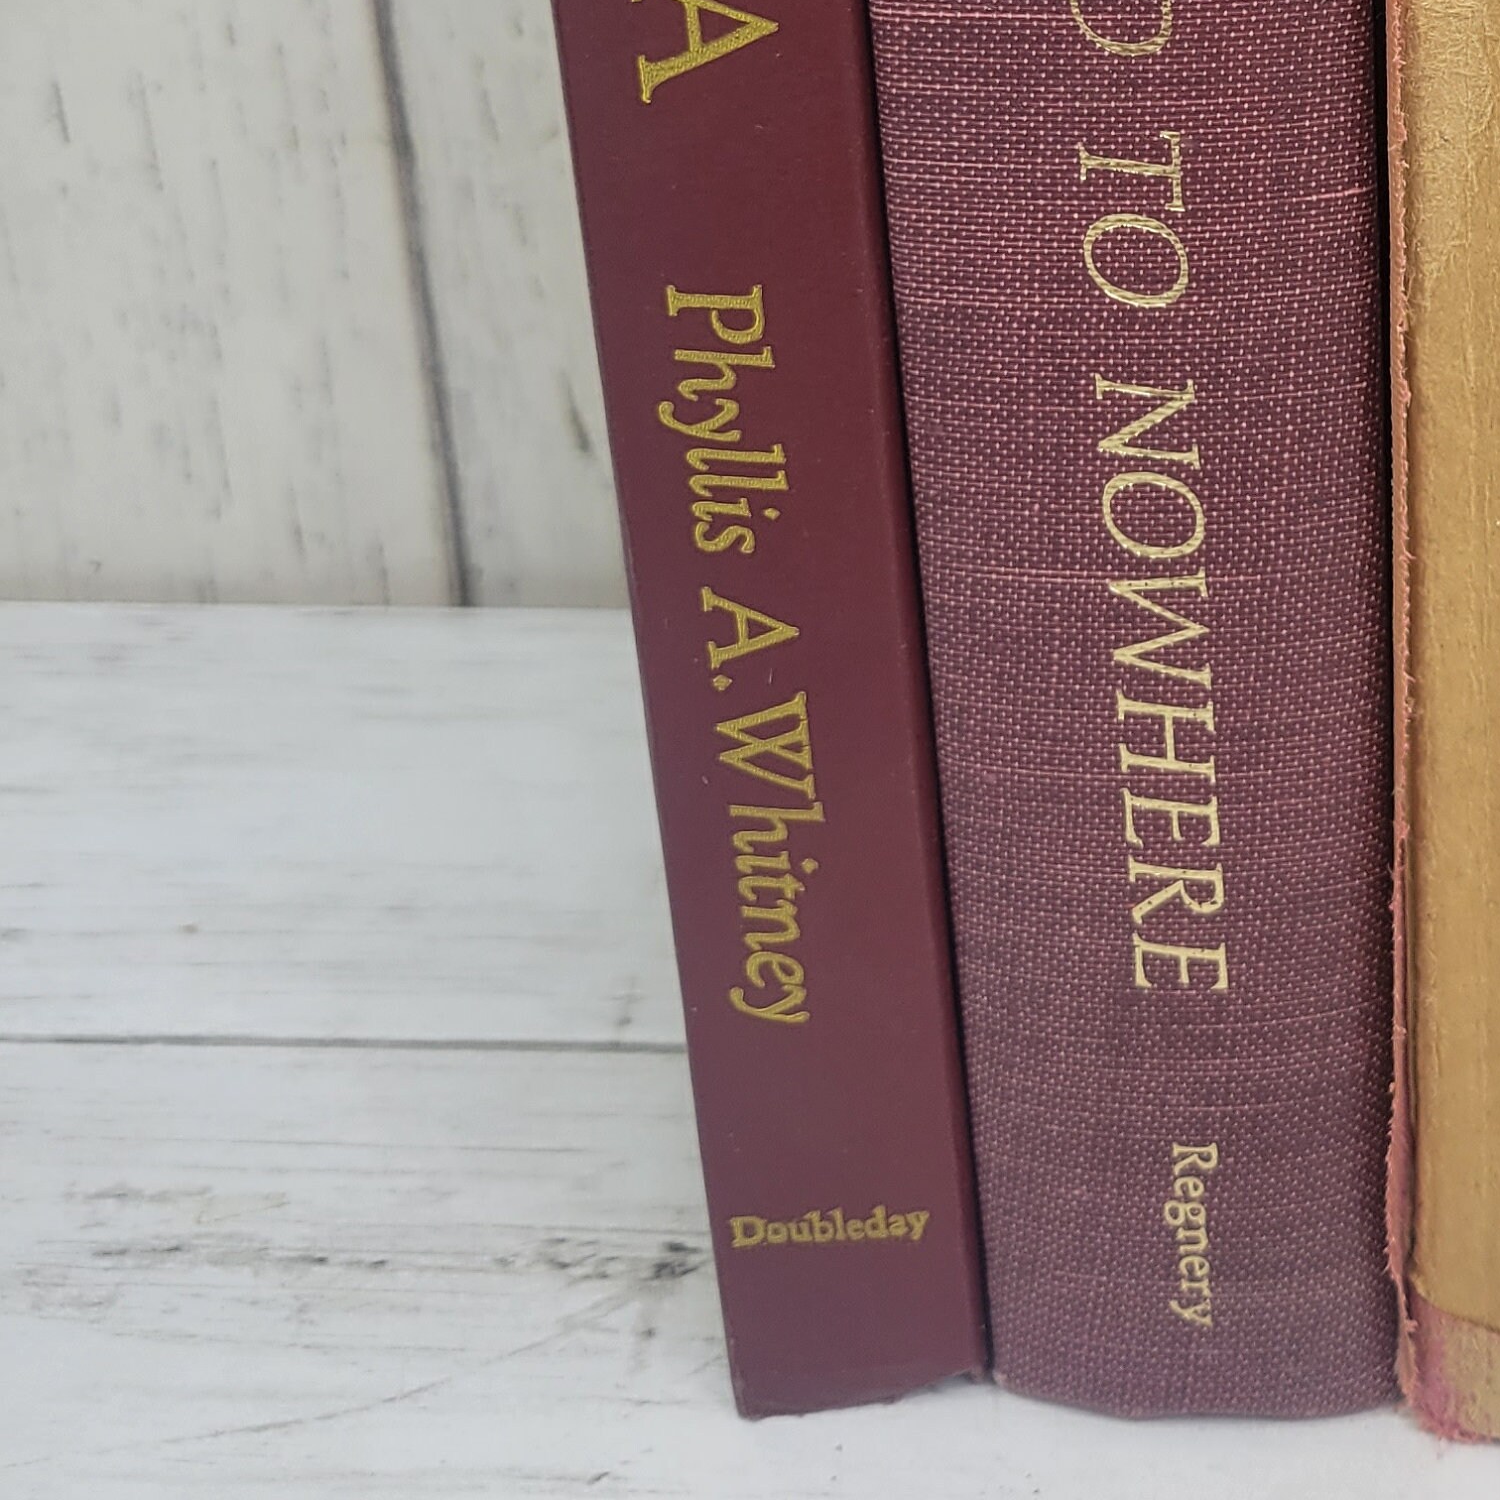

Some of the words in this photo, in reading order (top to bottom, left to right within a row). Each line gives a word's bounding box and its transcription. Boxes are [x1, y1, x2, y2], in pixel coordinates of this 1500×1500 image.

[1078, 131, 1190, 309] TO
[658, 284, 789, 553] Phyllis
[701, 586, 799, 691] A.
[1095, 373, 1230, 991] NOWHERE
[715, 690, 826, 1023] Whitney
[730, 1207, 930, 1265] Doubleday
[1163, 1141, 1220, 1328] Regnery
